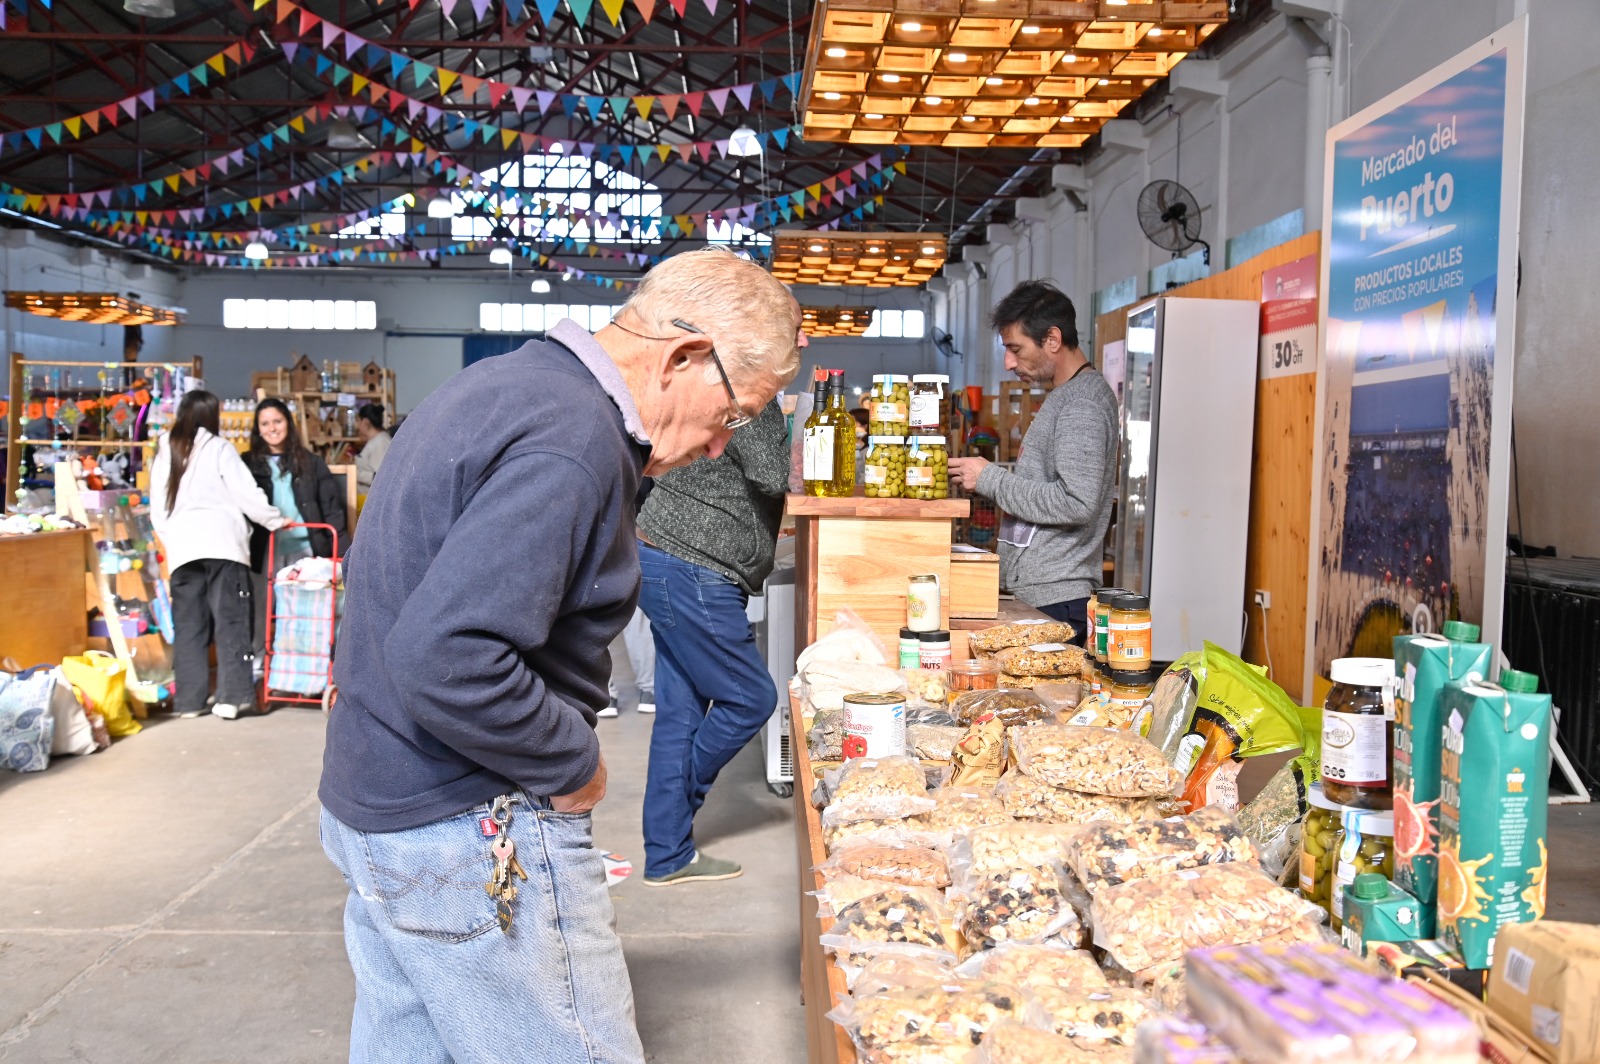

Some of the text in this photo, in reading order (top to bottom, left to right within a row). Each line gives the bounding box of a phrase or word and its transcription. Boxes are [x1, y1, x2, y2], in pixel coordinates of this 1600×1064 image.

[1361, 115, 1457, 187] Mercado del
[1360, 172, 1454, 241] Puerto
[1354, 245, 1463, 293] PRODUCTOS LOCALES
[1353, 271, 1462, 312] CON PRECIOS POPULARES
[1275, 340, 1292, 369] 30
[1293, 349, 1303, 364] off
[921, 657, 943, 665] COCO
